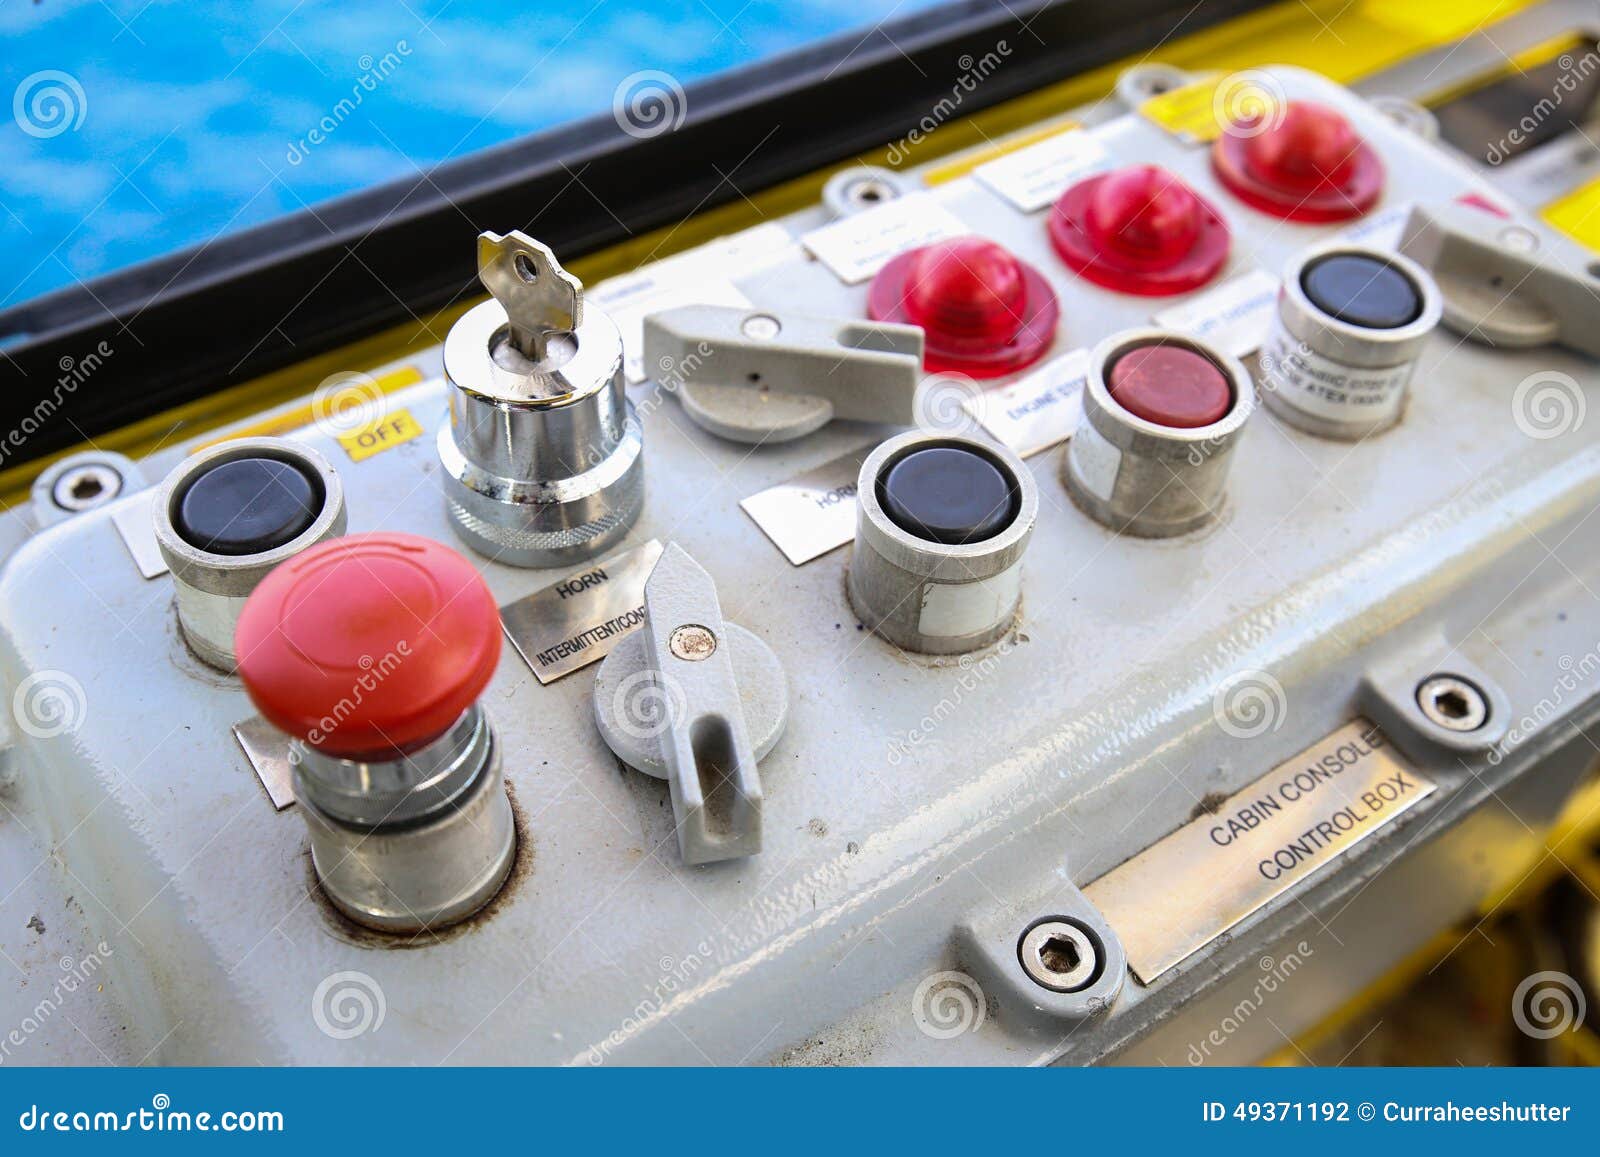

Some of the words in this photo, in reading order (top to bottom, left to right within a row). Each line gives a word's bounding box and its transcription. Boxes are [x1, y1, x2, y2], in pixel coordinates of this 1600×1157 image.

[357, 419, 404, 448] OFF
[556, 568, 609, 600] HORN
[1210, 795, 1282, 846] CABIN
[1279, 731, 1385, 802] CONSOLE
[1259, 807, 1368, 880] CONTROL
[1361, 772, 1415, 812] BOX
